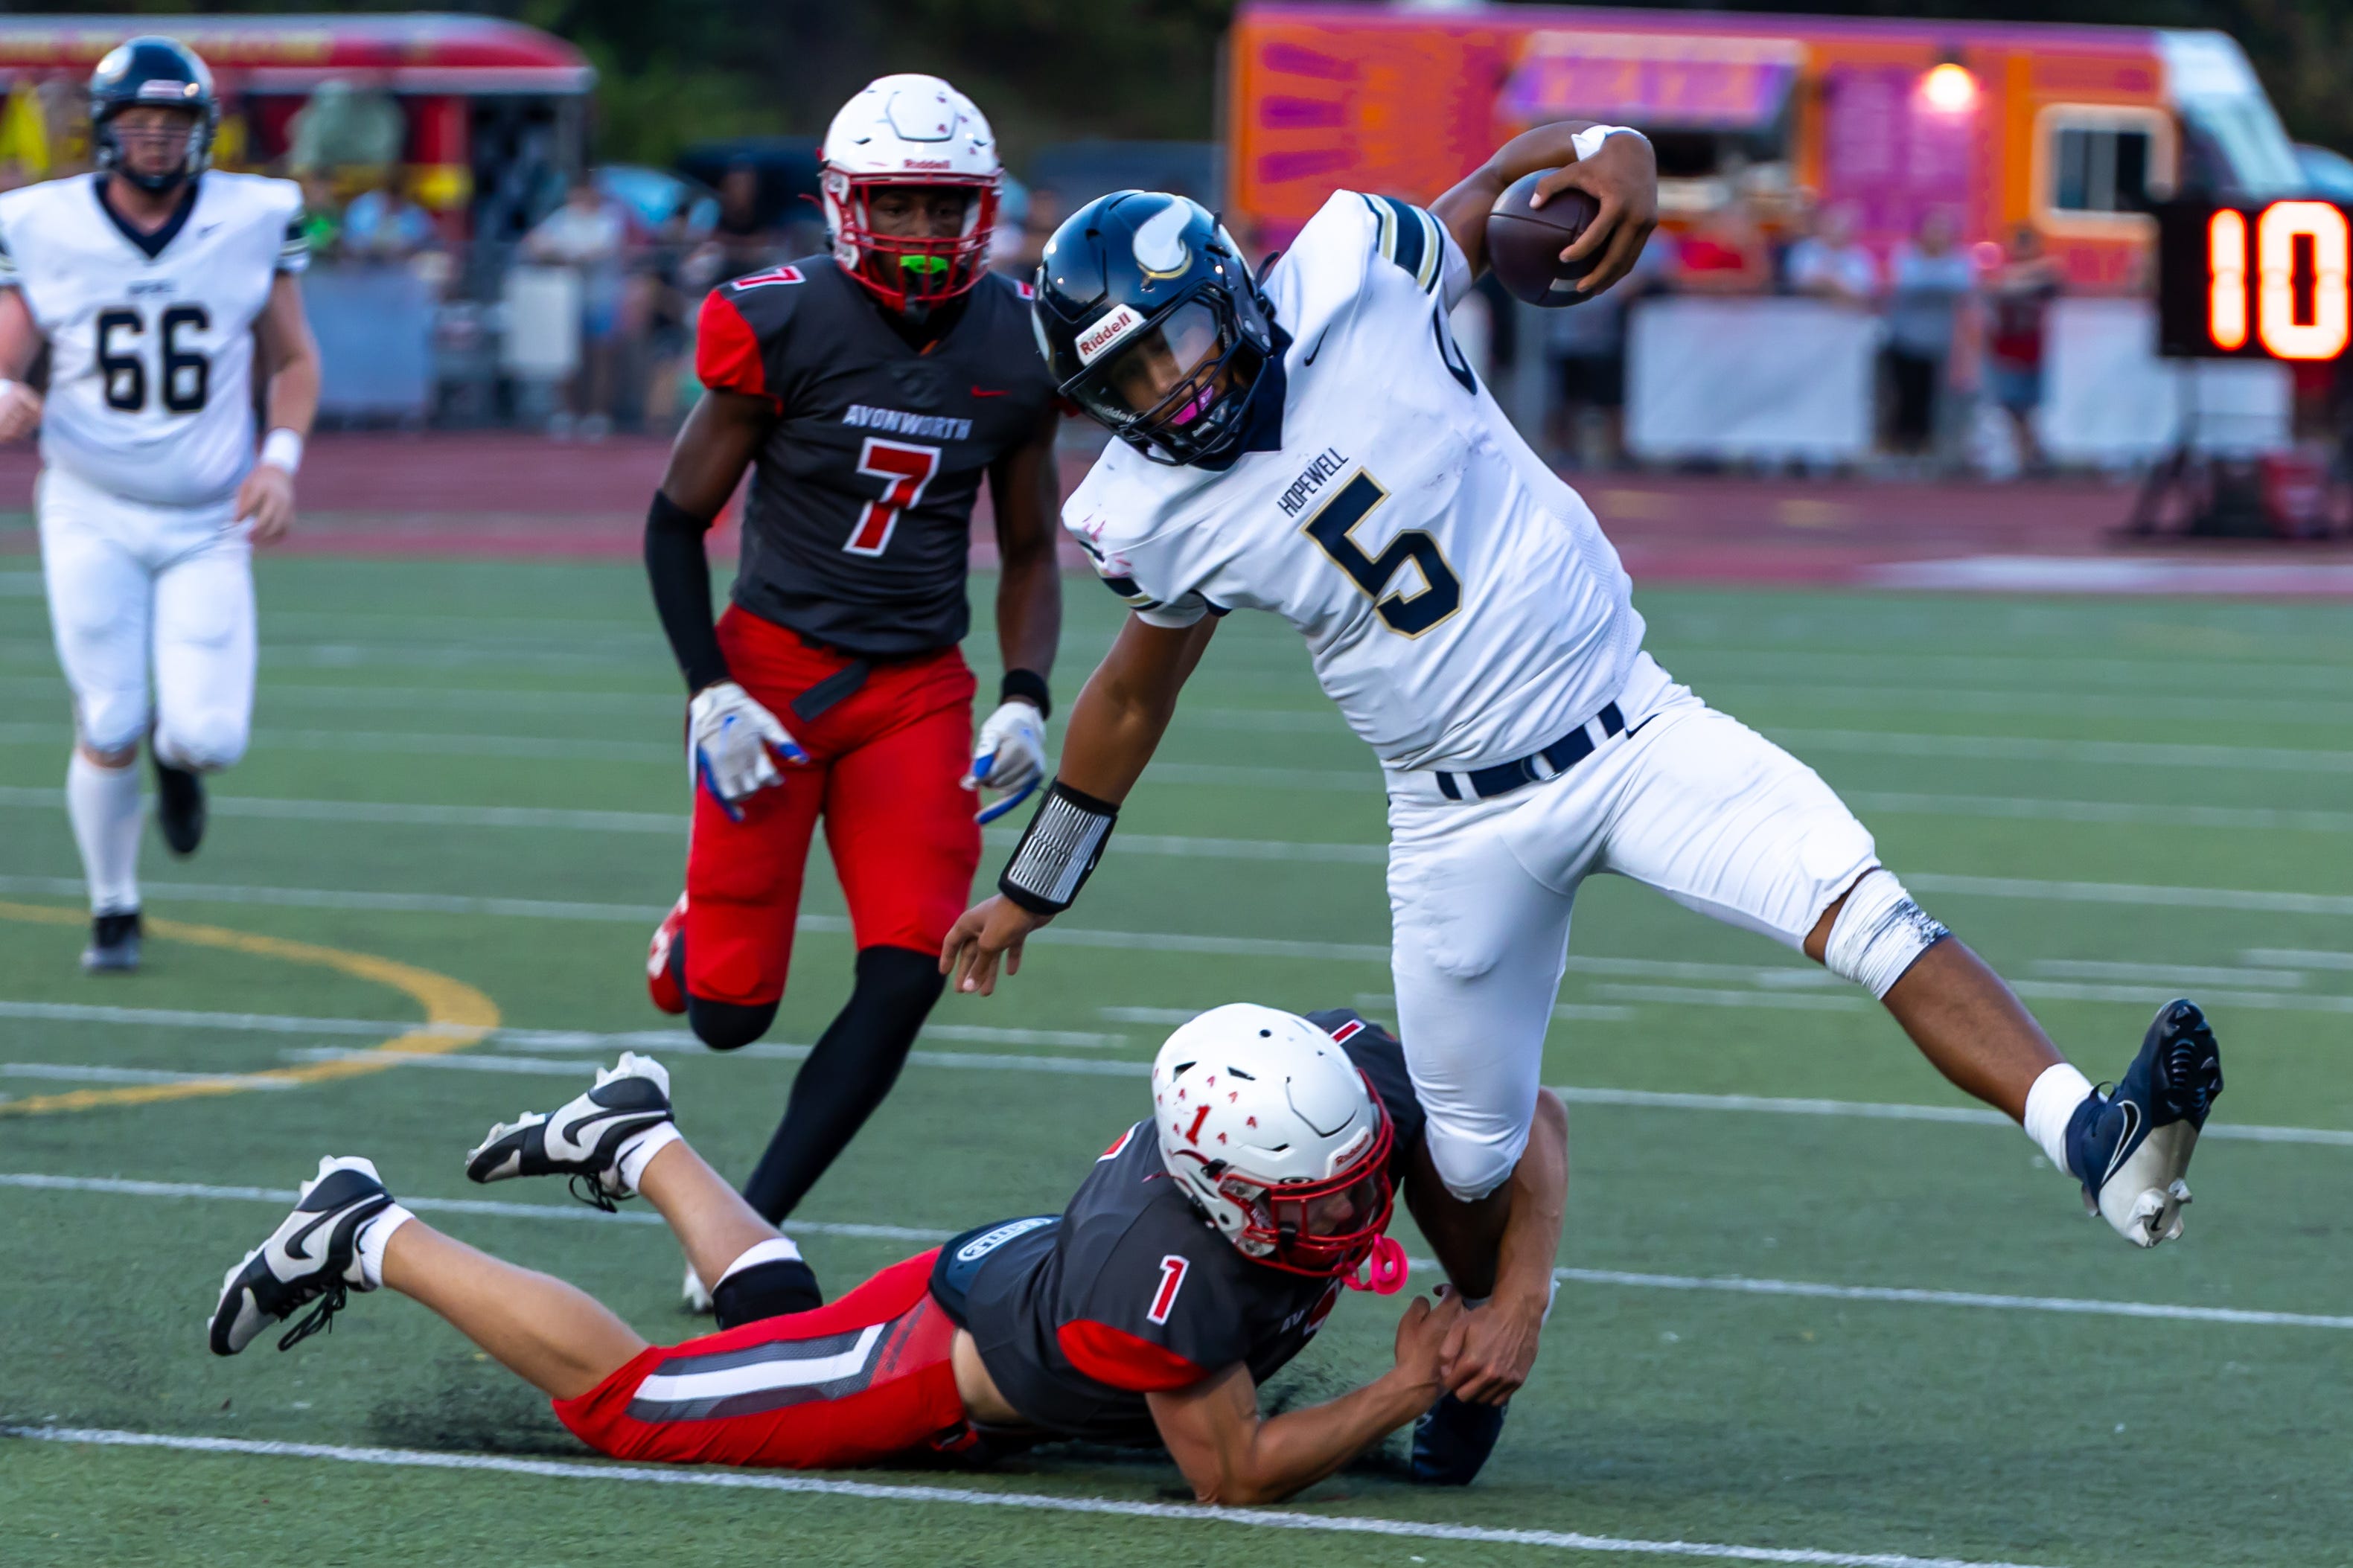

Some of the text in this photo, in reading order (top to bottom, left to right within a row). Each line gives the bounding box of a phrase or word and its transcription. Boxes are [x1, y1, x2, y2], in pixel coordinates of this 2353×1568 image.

[2208, 199, 2349, 360] 10
[98, 304, 210, 414] 66
[1079, 312, 1131, 356] Riddell
[842, 404, 973, 441] AVONWORTH
[841, 436, 942, 557] 7
[1276, 447, 1350, 518] HOPEWELL
[1299, 465, 1464, 641] 5
[1185, 1104, 1212, 1148] 1
[1146, 1255, 1190, 1326] 1
